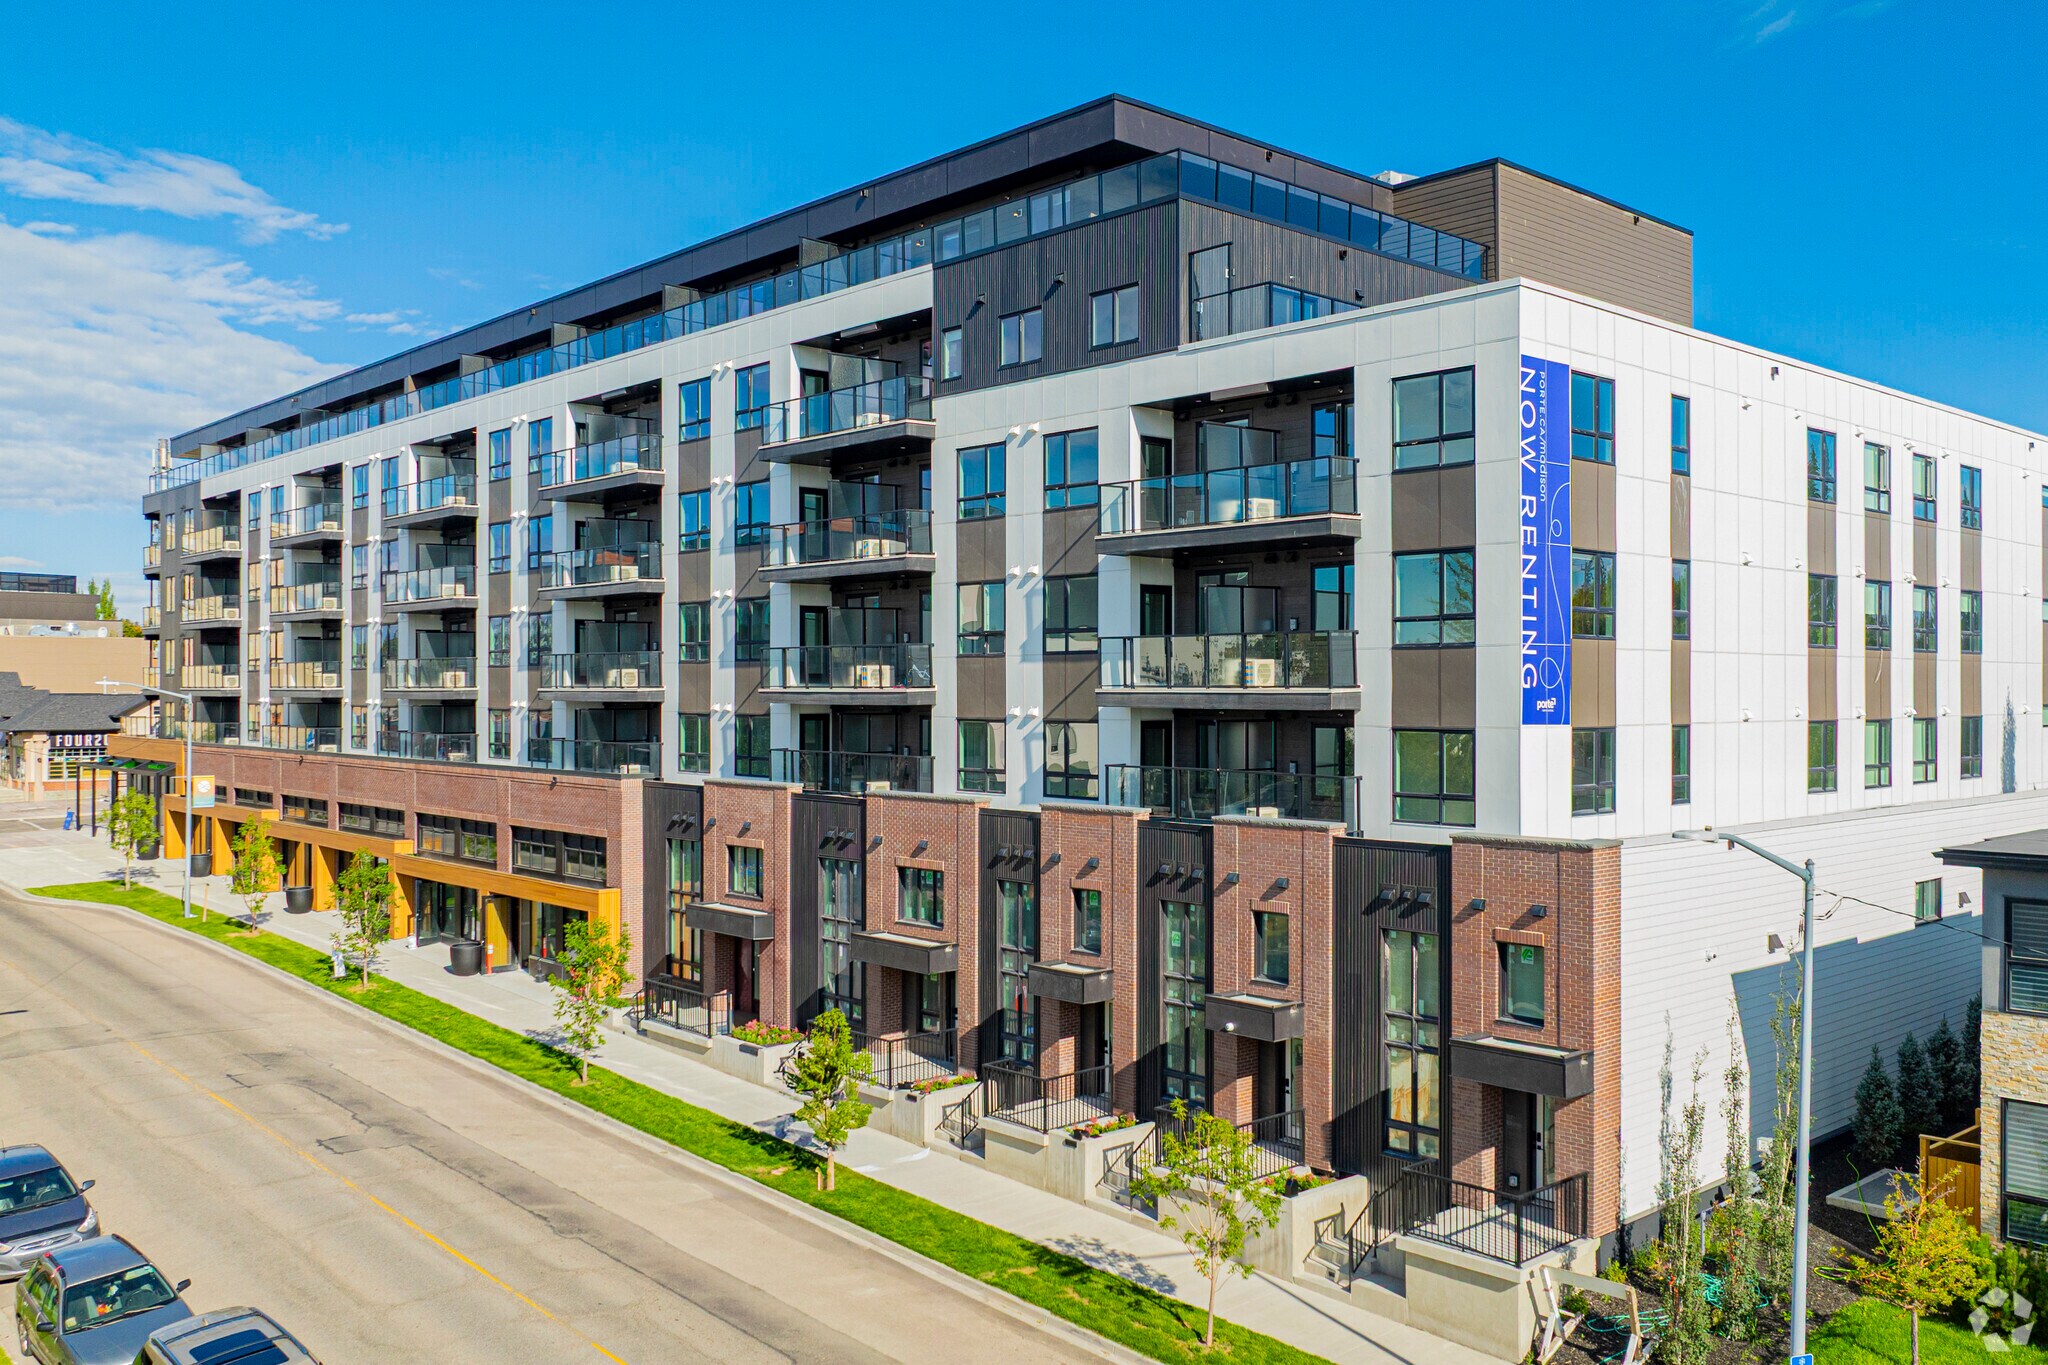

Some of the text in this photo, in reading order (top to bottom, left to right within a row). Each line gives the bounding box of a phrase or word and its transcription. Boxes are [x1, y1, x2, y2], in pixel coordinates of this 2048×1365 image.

[1520, 367, 1538, 689] NOW RENTING
[1539, 371, 1547, 502] PORTE.CA/madison
